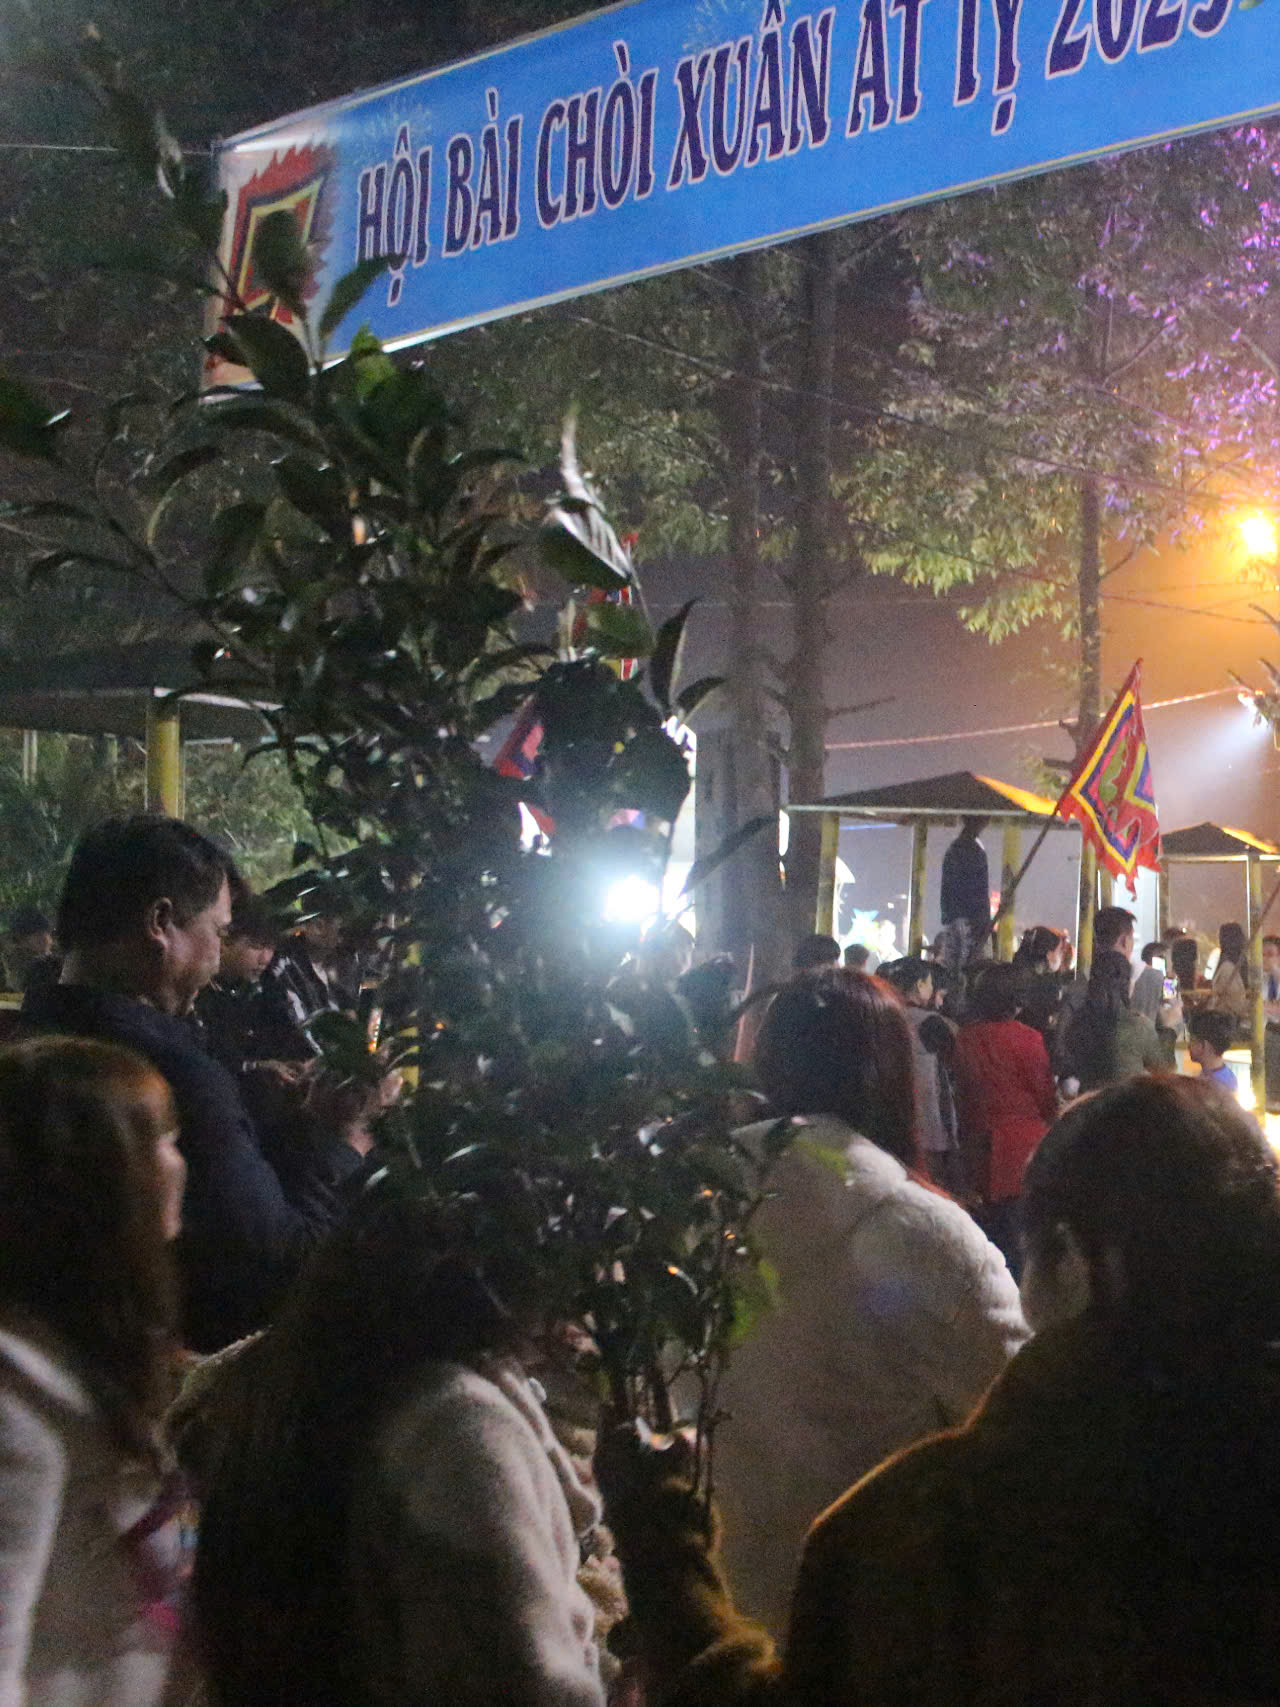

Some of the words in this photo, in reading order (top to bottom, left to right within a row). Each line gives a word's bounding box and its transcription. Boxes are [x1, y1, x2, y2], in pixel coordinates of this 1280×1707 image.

[356, 122, 433, 308] HỘI
[441, 87, 523, 258] BÀI
[535, 40, 659, 230] CHÒI
[666, 0, 836, 191] XUÂN
